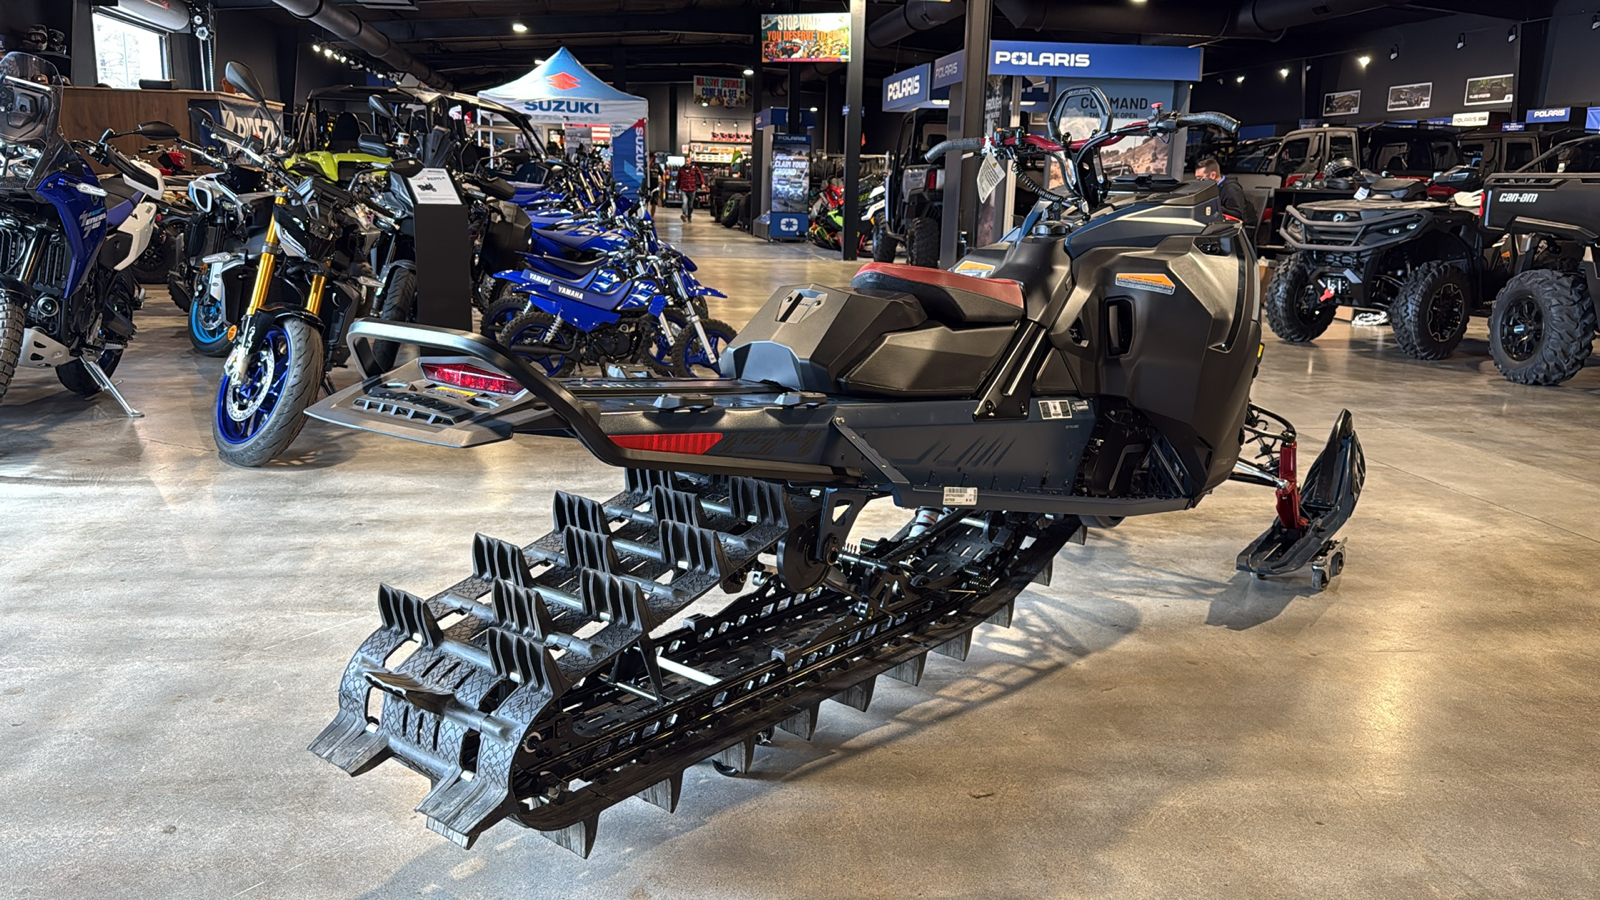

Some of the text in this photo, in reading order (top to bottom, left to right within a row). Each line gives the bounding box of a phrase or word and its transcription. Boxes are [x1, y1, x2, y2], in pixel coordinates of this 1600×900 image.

[777, 15, 799, 31] STOP
[767, 30, 782, 41] YOU
[783, 30, 815, 41] DESERVE
[816, 30, 828, 41] TO
[994, 51, 1091, 68] POLARIS
[935, 62, 958, 79] POLARIS
[887, 74, 920, 102] POLARIS
[524, 100, 599, 114] SUZUKI
[1081, 97, 1148, 110] COMAND
[1533, 109, 1566, 118] POLARIS
[635, 126, 644, 176] SUZUKI
[774, 160, 807, 169] CLAIM YOUR
[529, 272, 552, 286] YAMAHA
[558, 285, 584, 300] YAMAHA
